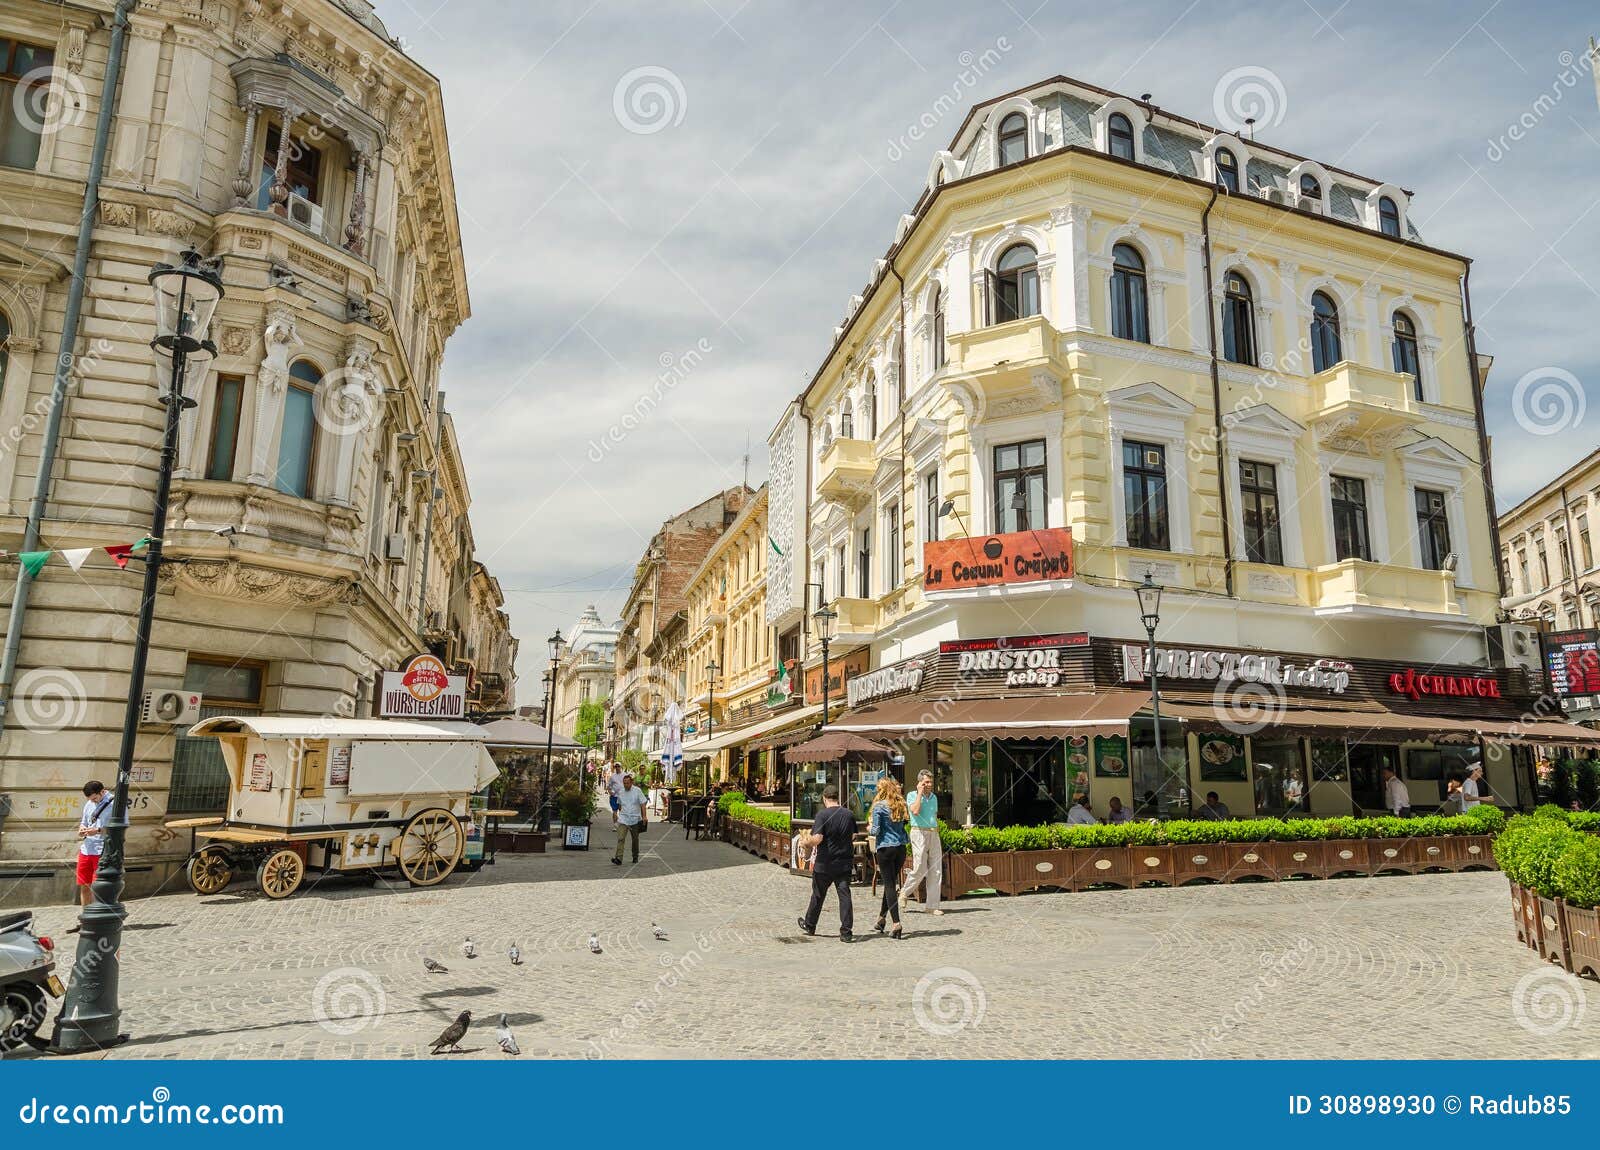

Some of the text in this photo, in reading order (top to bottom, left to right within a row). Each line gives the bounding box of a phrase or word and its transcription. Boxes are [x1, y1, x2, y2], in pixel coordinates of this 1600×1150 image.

[925, 564, 943, 585] La
[959, 649, 1061, 671] DRISTOR
[1143, 648, 1349, 694] DRISTOR kebap
[1005, 669, 1060, 688] kebap
[386, 689, 461, 716] WÜRSTELSTAND
